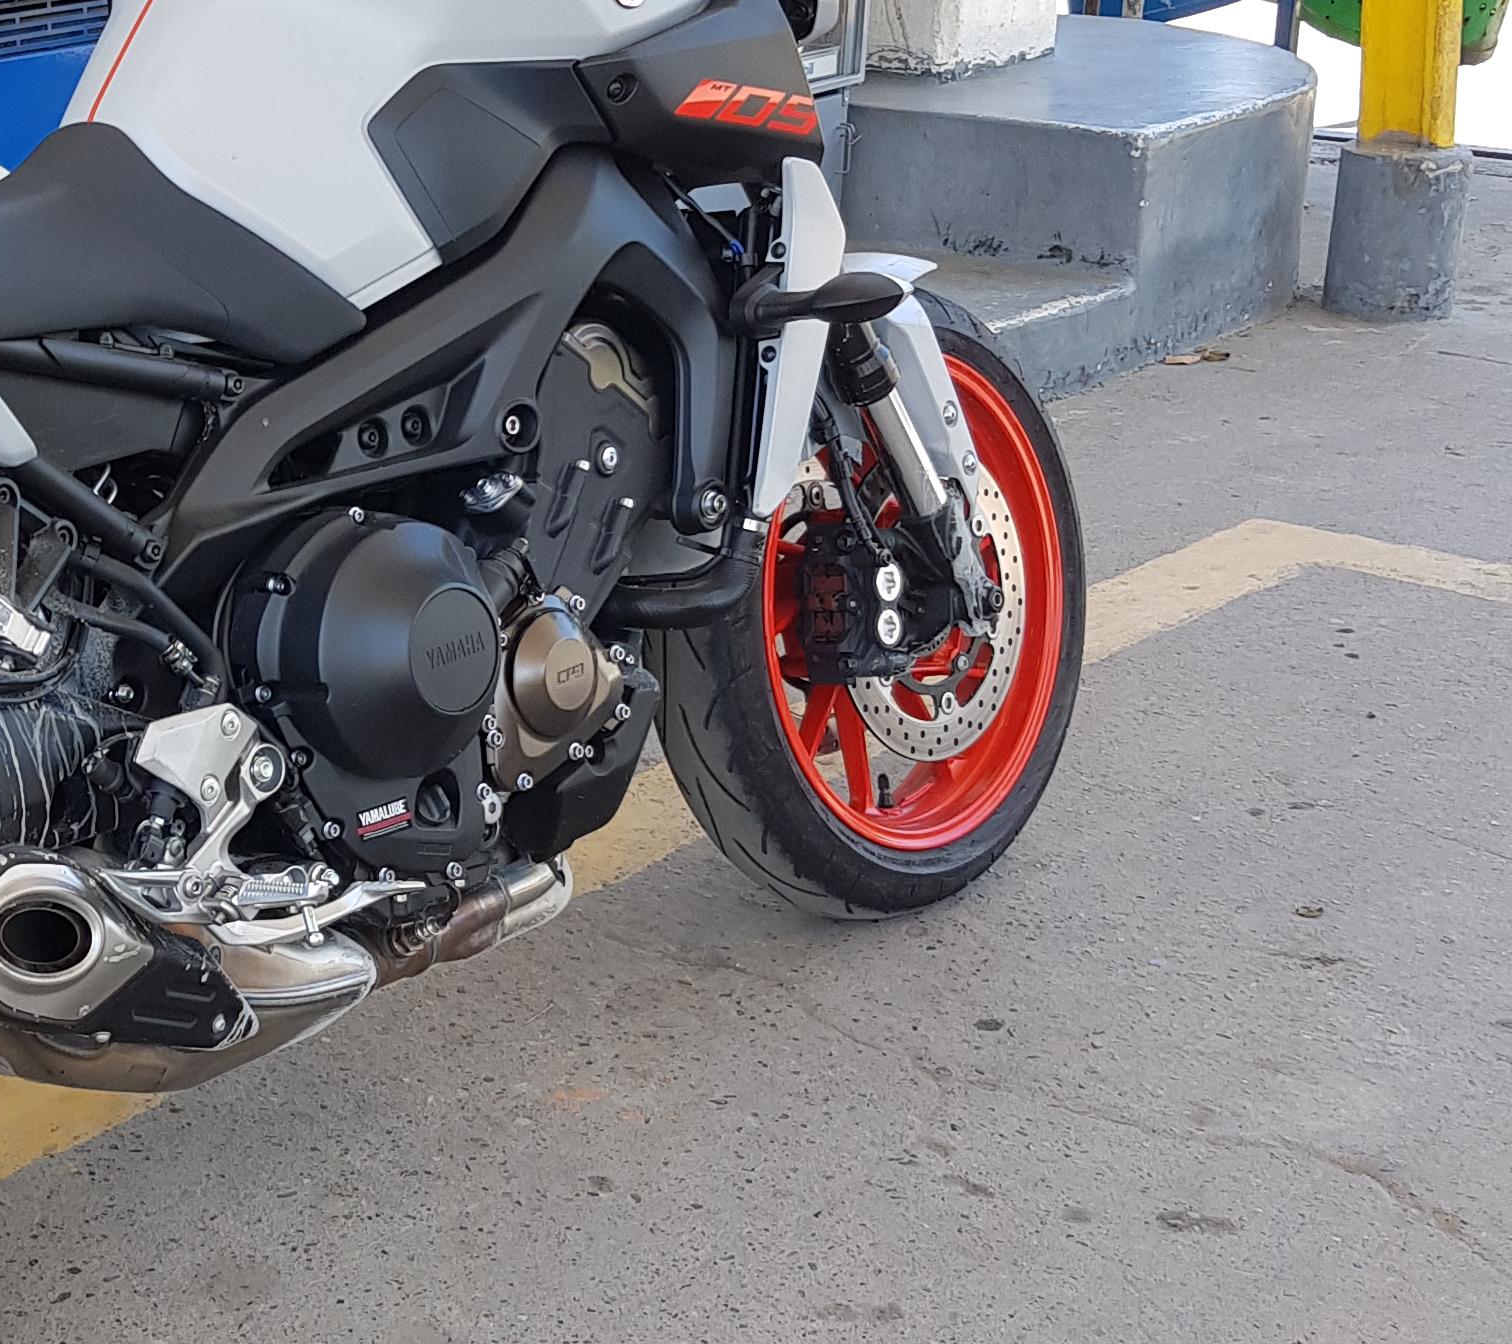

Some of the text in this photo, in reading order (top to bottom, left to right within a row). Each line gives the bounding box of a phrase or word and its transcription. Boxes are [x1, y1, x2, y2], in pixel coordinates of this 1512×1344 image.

[710, 84, 732, 92] MT
[426, 631, 486, 670] YAMAHA
[359, 799, 407, 827] YAMALUBE
